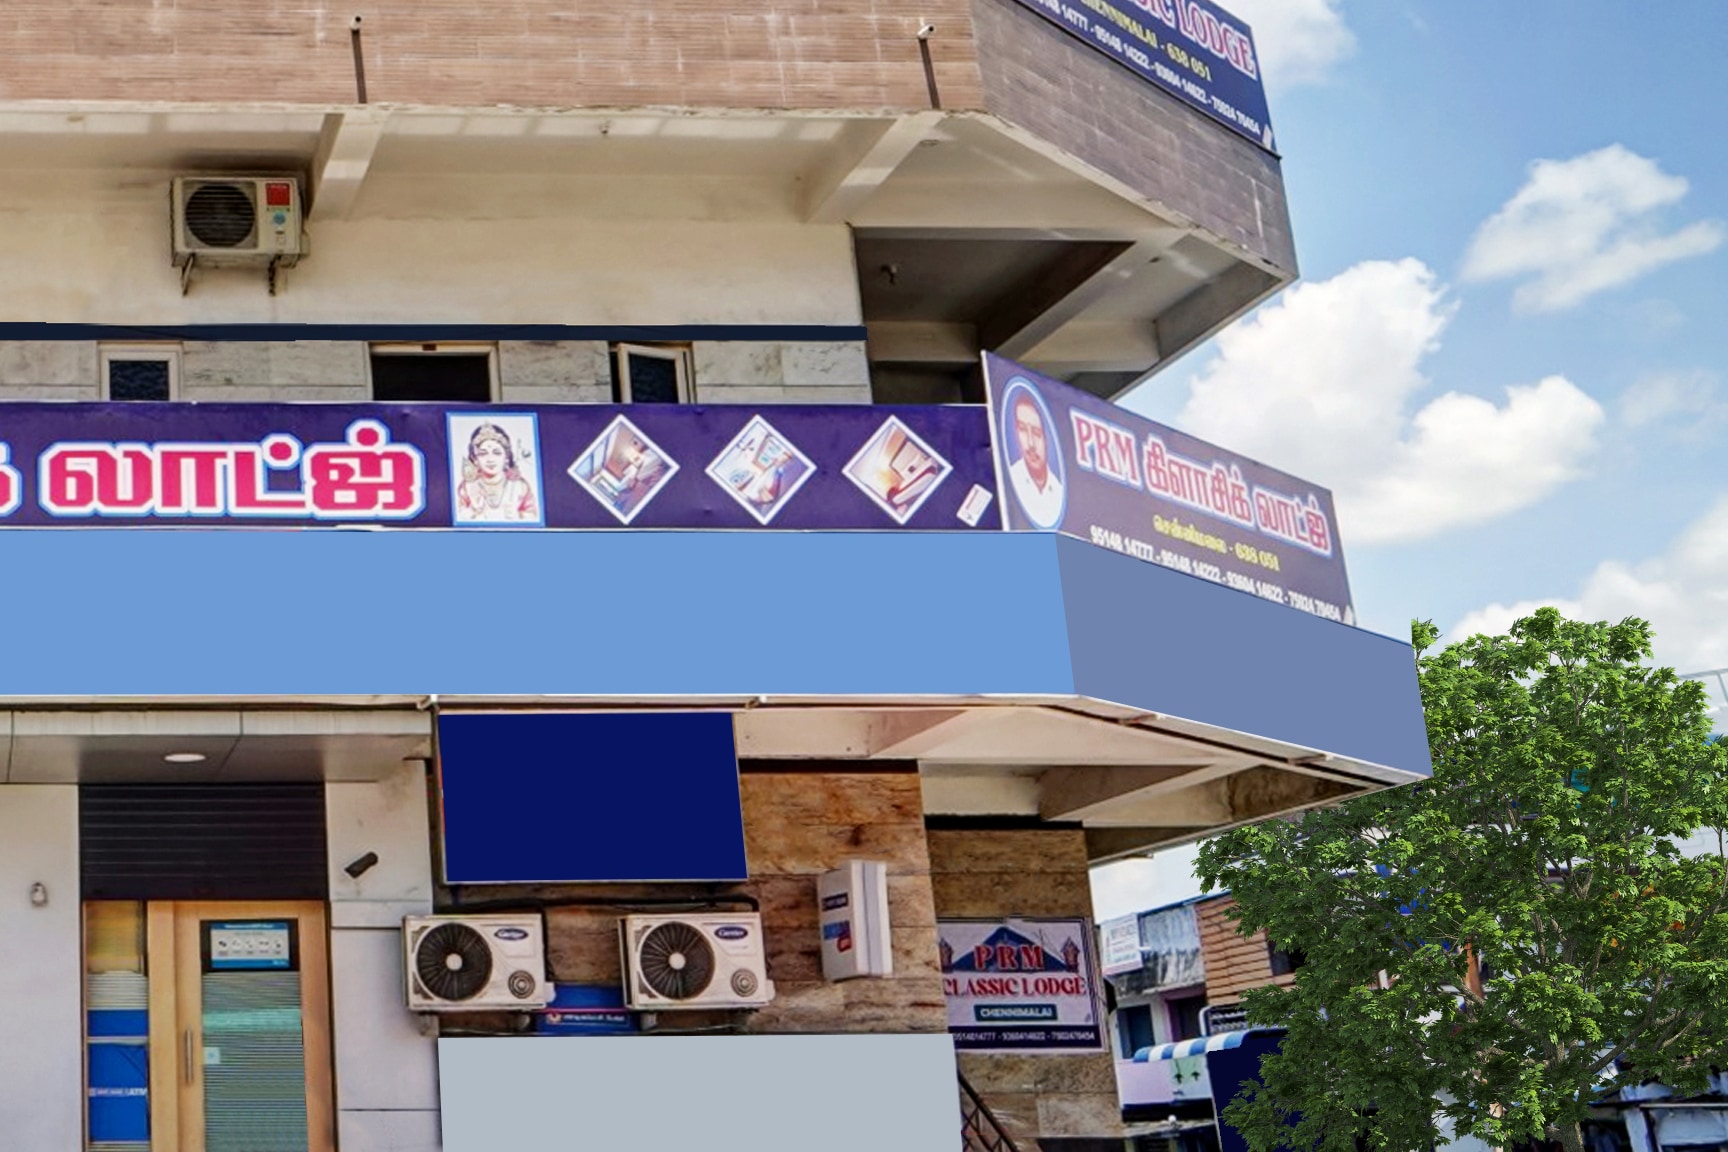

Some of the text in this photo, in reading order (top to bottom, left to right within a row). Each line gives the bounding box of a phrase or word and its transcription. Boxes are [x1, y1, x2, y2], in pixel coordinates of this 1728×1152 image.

[1166, 42, 1189, 68] 638
[1190, 56, 1212, 82] 051
[41, 419, 427, 519] லாட்ஜ்
[1069, 408, 1335, 557] PRM கிளாசிக் லாட்ஜ்
[1090, 525, 1124, 552] 95148
[1235, 541, 1258, 566] 638
[1257, 550, 1281, 572] 051
[974, 944, 1045, 971] PRM
[943, 976, 1088, 997] CLASSIC LODGE
[980, 1008, 1053, 1018] CHENNIMALAI
